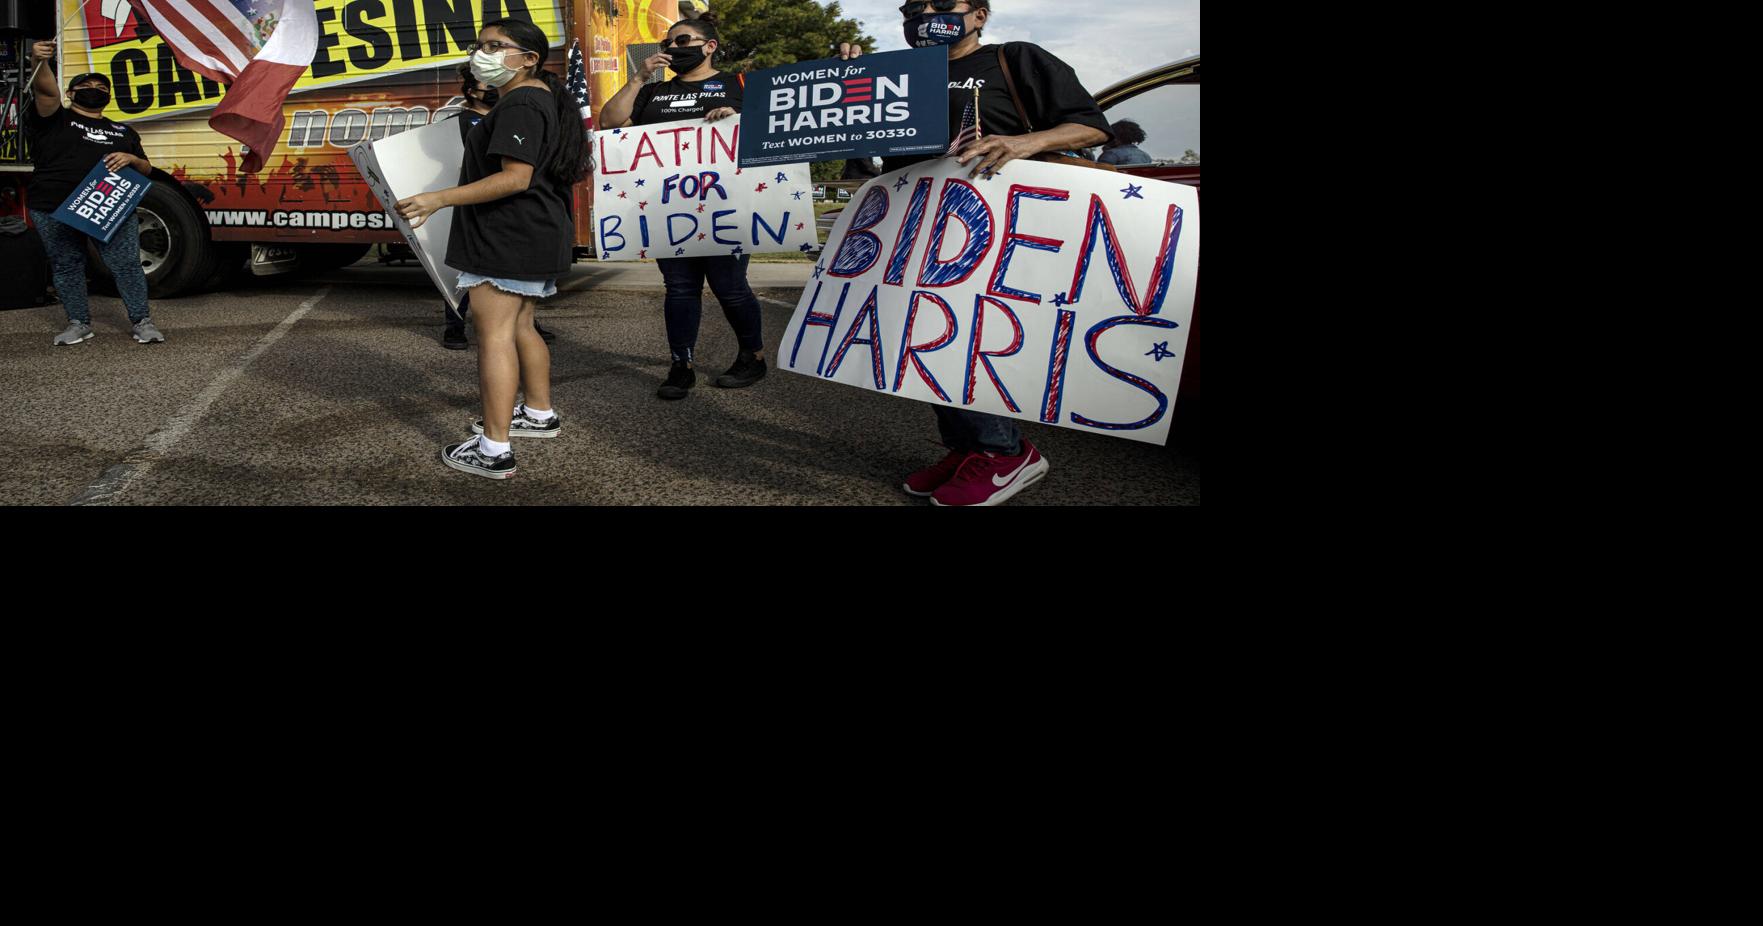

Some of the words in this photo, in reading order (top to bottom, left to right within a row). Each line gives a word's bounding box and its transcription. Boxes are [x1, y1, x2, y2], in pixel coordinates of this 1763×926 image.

[929, 28, 960, 37] HARRIS
[930, 22, 961, 32] BIDEN
[110, 0, 535, 114] CAESINA
[771, 67, 840, 86] WOMEN
[841, 65, 866, 79] for
[652, 94, 680, 103] PONTE
[680, 92, 698, 100] LAS
[699, 91, 727, 99] PILAS
[769, 73, 909, 113] BIDEN
[678, 106, 704, 114] Charged
[768, 101, 911, 134] HARRIS
[762, 140, 785, 150] Text
[788, 133, 847, 148] WOMEN
[850, 132, 863, 141] to
[866, 127, 917, 140] 30330
[67, 186, 92, 212] WOMEN
[75, 172, 122, 219] BIDEN
[90, 178, 132, 226] HARRIS
[661, 170, 728, 204] FOR
[108, 202, 127, 222] WOMEN
[600, 209, 791, 252] BIDEN
[827, 176, 1183, 316] BIDEN
[790, 281, 1179, 430] HARRIS
